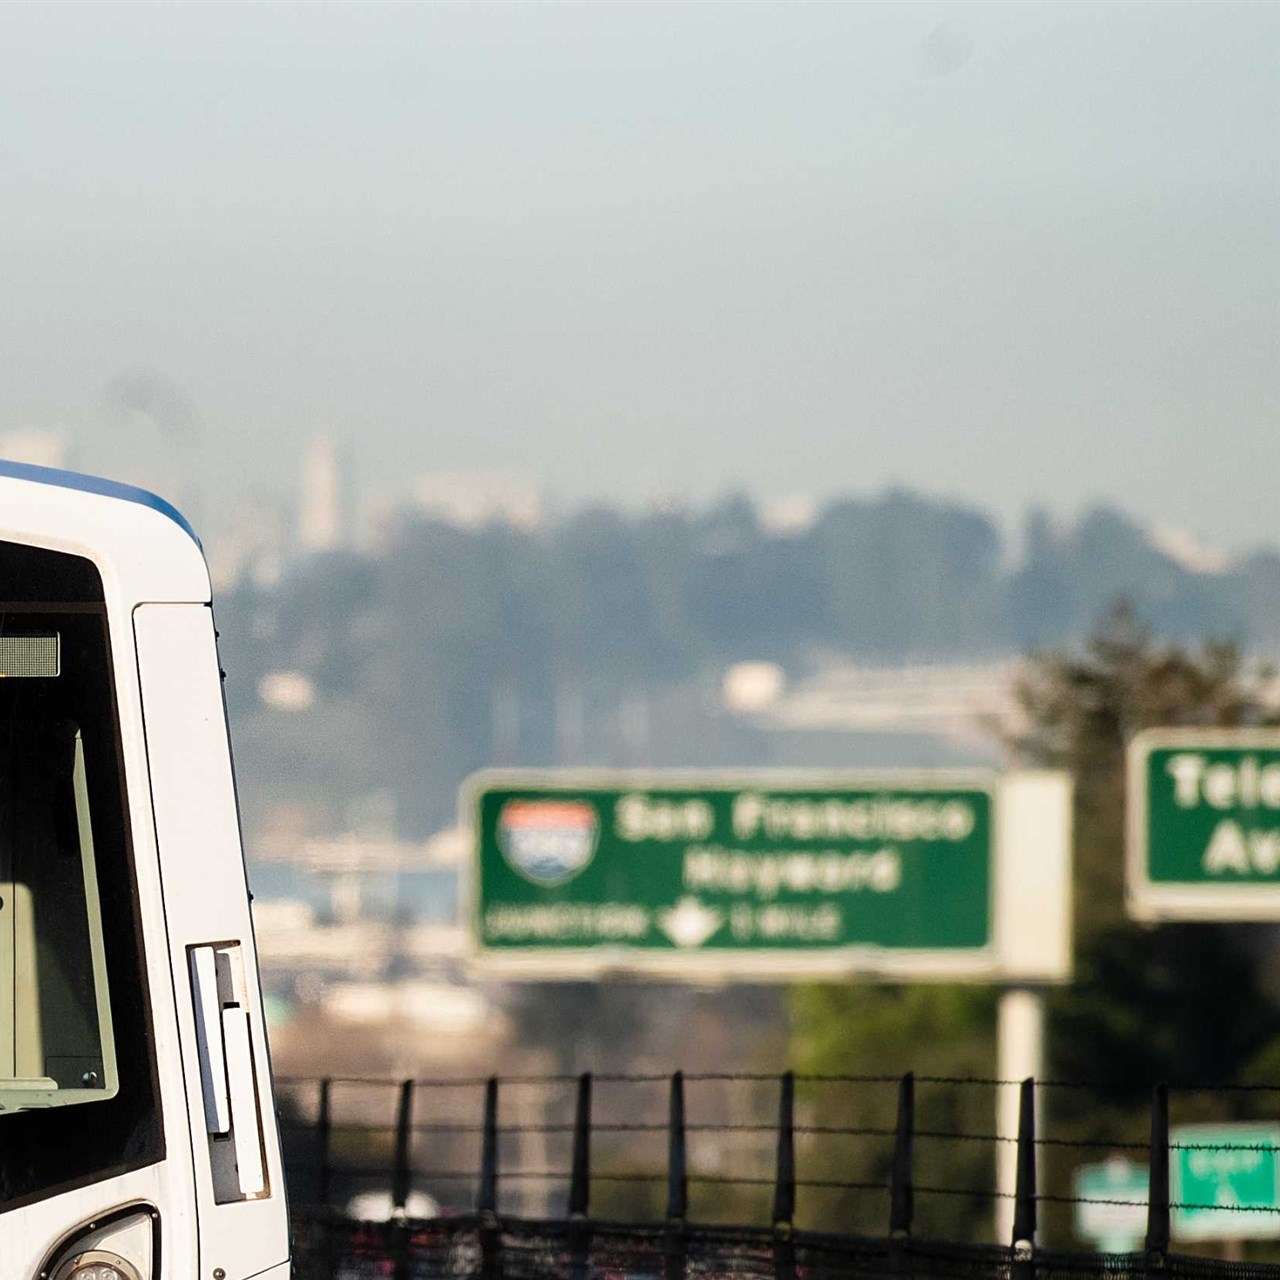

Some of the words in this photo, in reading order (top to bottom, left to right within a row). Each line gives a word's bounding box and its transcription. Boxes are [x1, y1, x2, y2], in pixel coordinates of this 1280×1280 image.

[616, 796, 713, 841] San
[732, 796, 974, 841] Francisco
[684, 848, 901, 898] Hayward
